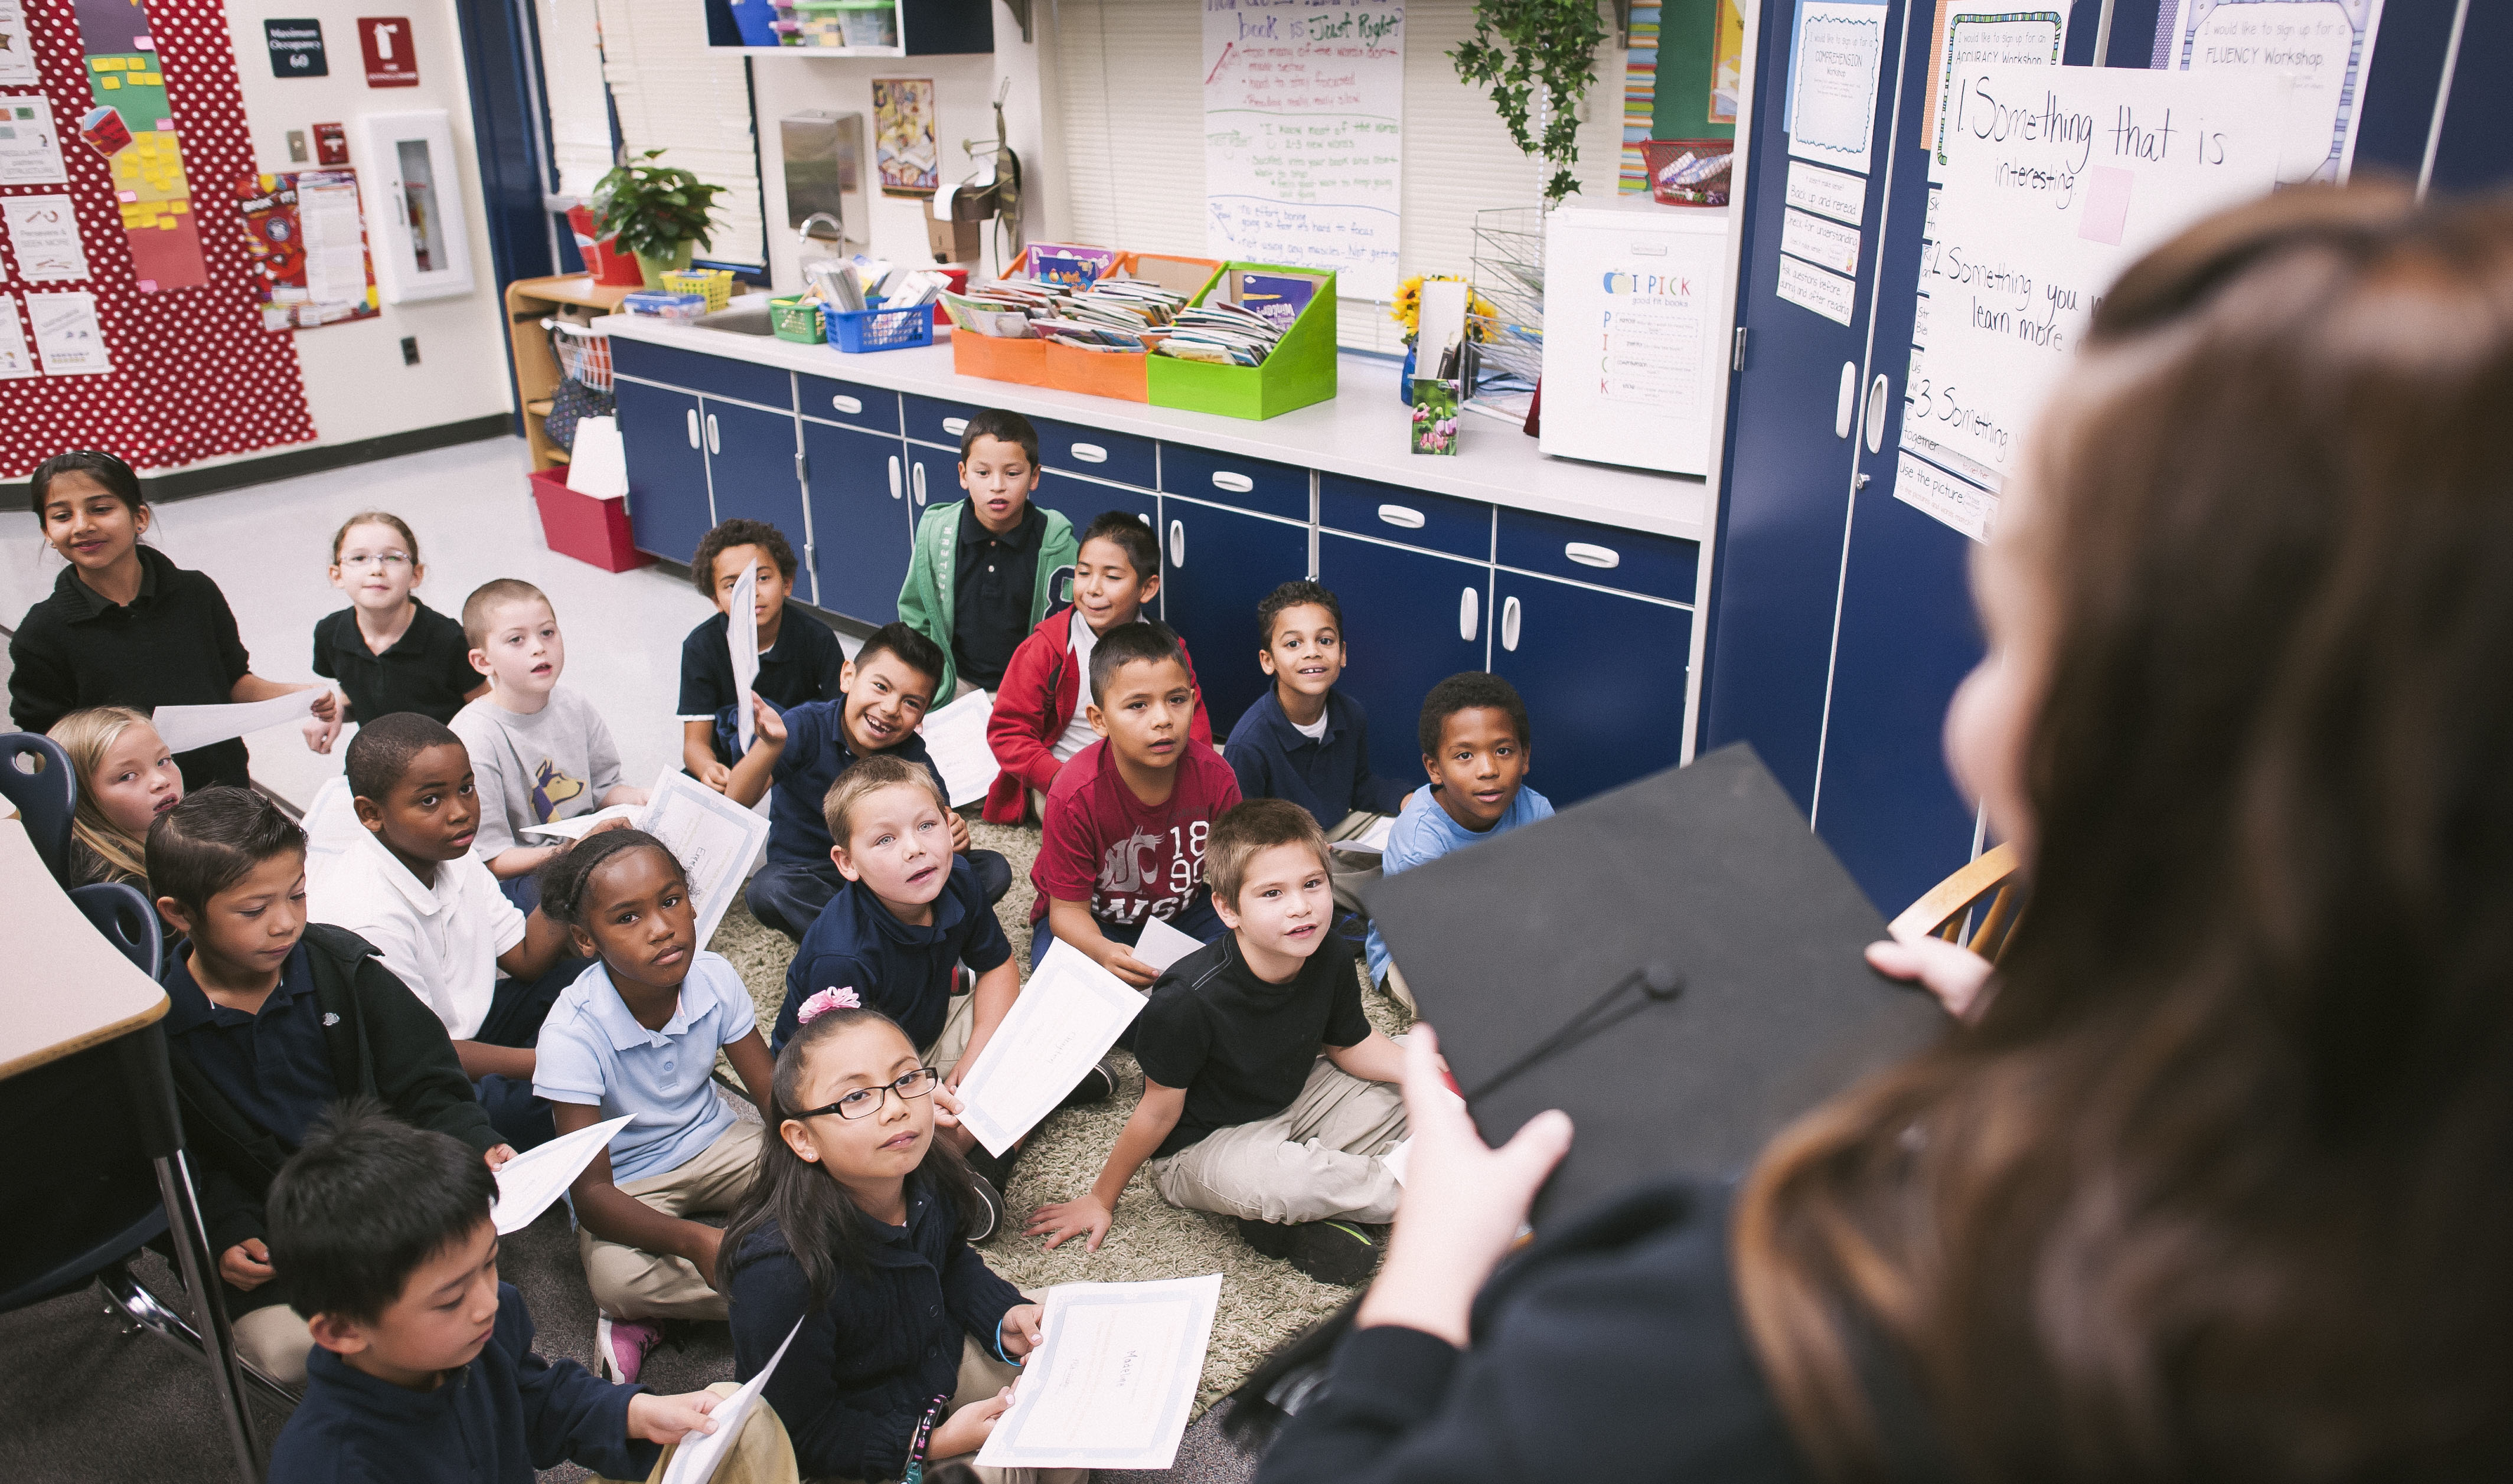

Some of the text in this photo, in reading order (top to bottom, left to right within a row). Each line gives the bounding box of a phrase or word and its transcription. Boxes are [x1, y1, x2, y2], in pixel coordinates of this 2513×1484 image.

[269, 27, 319, 39] Maximum
[1307, 12, 1353, 41] Just
[2204, 21, 2346, 41] I would like to sign up for a
[269, 39, 322, 51] Occupancy
[1810, 31, 1813, 42] I
[1814, 33, 1825, 43] would
[1836, 34, 1840, 44] to
[1842, 35, 1851, 49] sign
[1852, 38, 1858, 48] up
[1860, 35, 1868, 47] for
[1869, 39, 1874, 48] a
[1957, 31, 1963, 43] I
[1964, 32, 1979, 43] would
[1981, 32, 1991, 43] like
[1993, 32, 1999, 43] to
[2002, 32, 2013, 47] sign
[2015, 35, 2022, 47] up
[2025, 32, 2035, 43] for
[289, 53, 309, 69] 60
[1815, 51, 1863, 67] COMPREHENSION
[1955, 50, 1999, 66] ACCURACY
[2205, 47, 2260, 64] FLUENCY
[1972, 76, 2093, 175] Something
[2107, 104, 2178, 162] that
[2198, 117, 2227, 165] is
[1809, 194, 1816, 208] up
[1819, 197, 1831, 207] and
[1833, 200, 1857, 215] reread
[1817, 227, 1858, 253] understanding
[1632, 274, 1691, 296] I PICK
[1792, 270, 1818, 286] questions
[1947, 247, 2031, 311] Something
[2037, 284, 2079, 331] you
[1631, 296, 1651, 306] good
[1665, 298, 1689, 308] books
[1808, 290, 1826, 304] after
[1827, 300, 1850, 321] reading
[1603, 310, 1611, 328] P
[1973, 296, 2063, 352] learn more
[1603, 334, 1608, 351] I
[1601, 356, 1608, 373] C
[1601, 378, 1609, 394] K
[1937, 387, 2008, 463] Something
[1899, 462, 1914, 478] Use
[1917, 469, 1930, 486] the
[1170, 821, 1210, 860] 18
